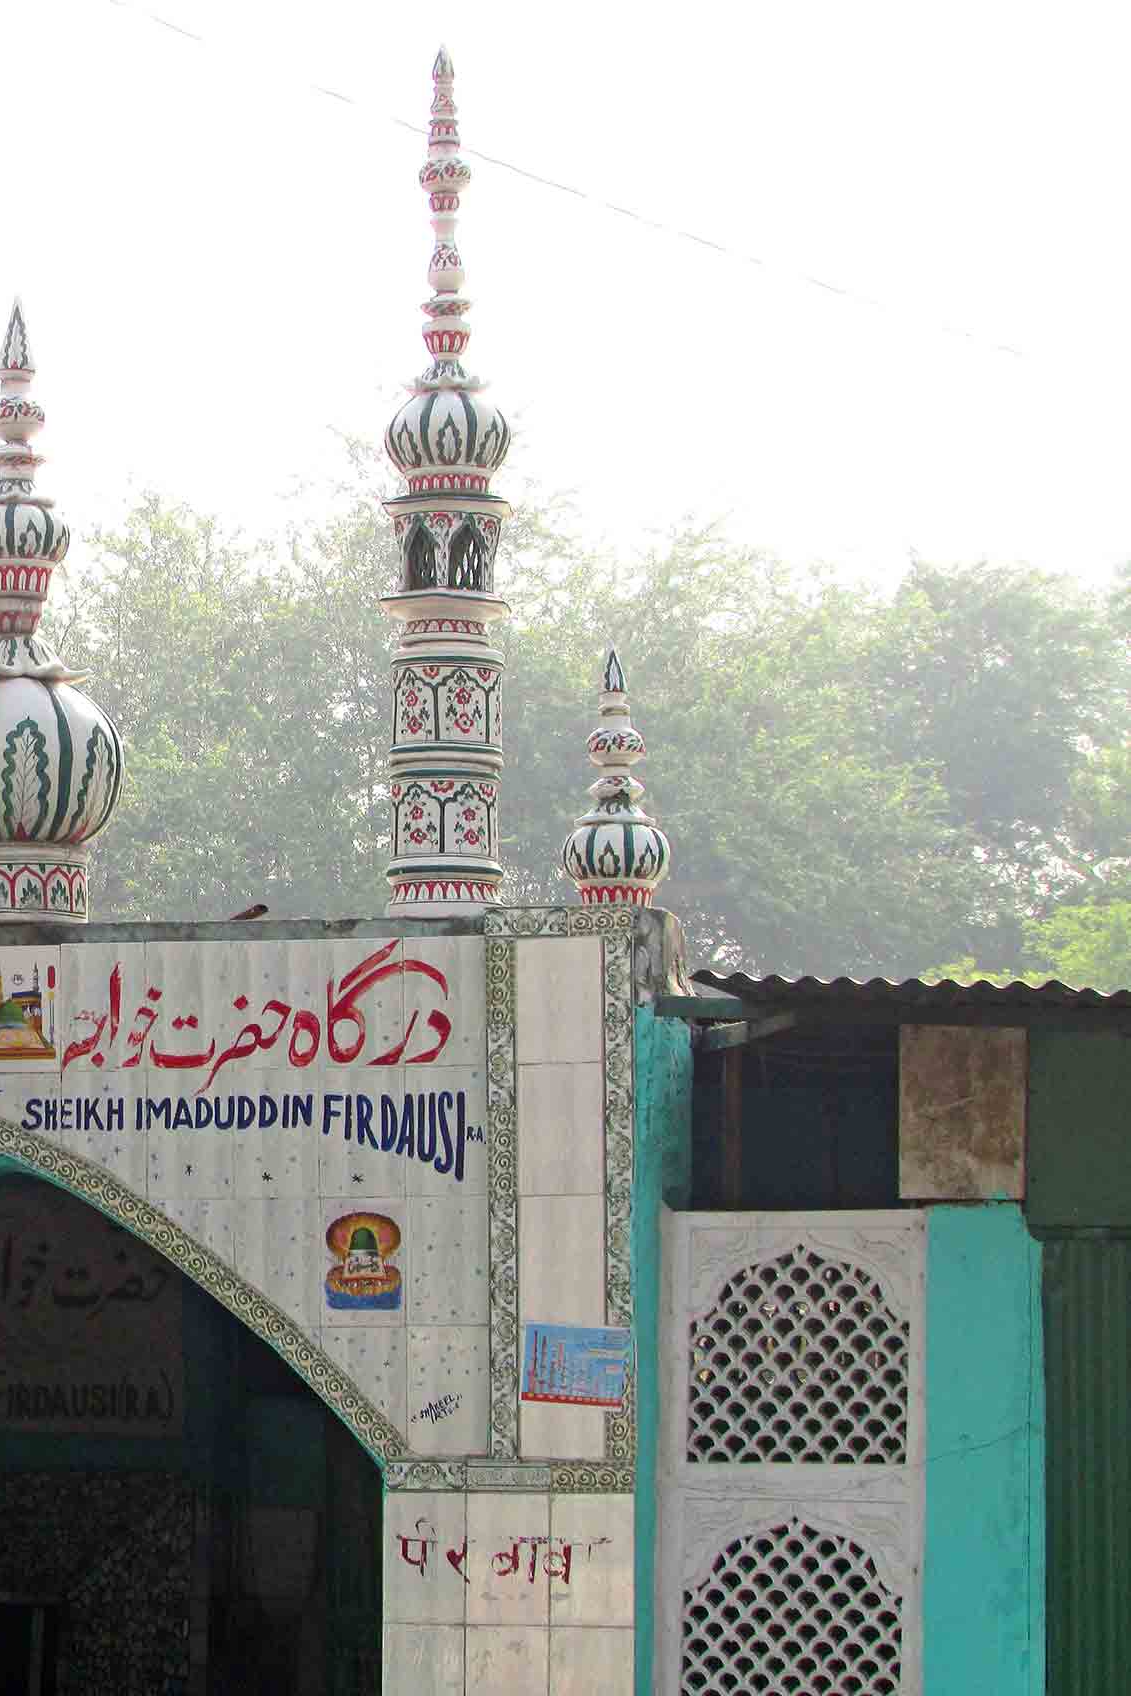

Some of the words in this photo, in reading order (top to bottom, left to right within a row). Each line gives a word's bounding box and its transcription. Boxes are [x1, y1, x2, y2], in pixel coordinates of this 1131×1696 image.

[149, 994, 293, 1096] حضرت
[21, 1097, 125, 1131] SHEIKH
[136, 1094, 313, 1131] IMADUDDIN
[323, 1091, 466, 1182] FIRDAUSI
